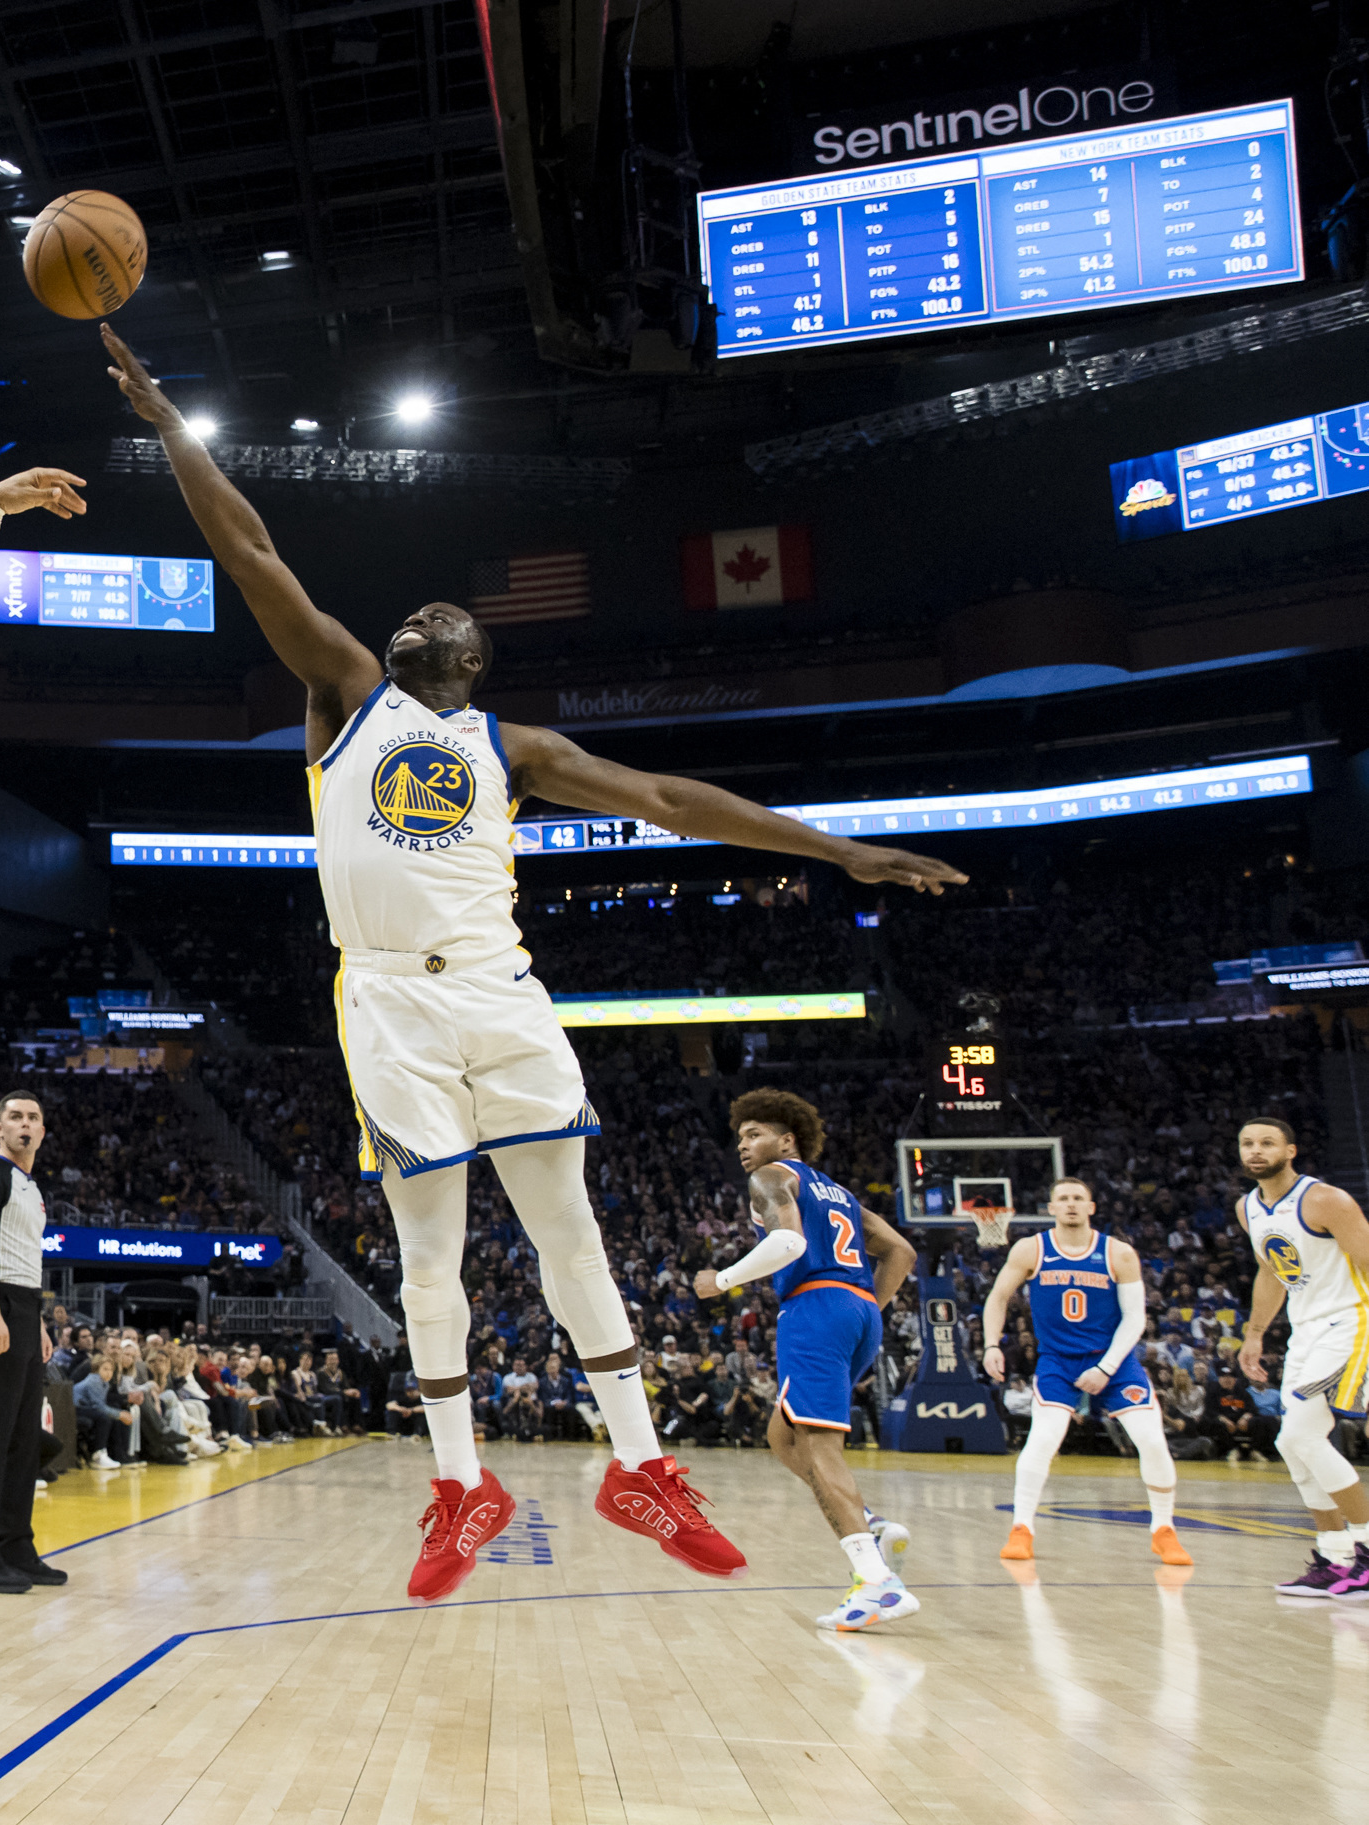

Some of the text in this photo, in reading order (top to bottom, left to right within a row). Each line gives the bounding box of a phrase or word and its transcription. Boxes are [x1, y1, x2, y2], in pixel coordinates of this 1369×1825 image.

[813, 80, 1154, 165] SentinelOne
[1059, 126, 1205, 160] NEW YORK TEAM STATS
[1160, 156, 1187, 169] BLK
[761, 172, 917, 207] GOLDEN STATE TEAM STATS
[1013, 165, 1107, 192] AST 14
[1161, 163, 1262, 190] TO 2
[865, 189, 956, 215] BLK 2
[1014, 187, 1109, 214] OREB 7
[1163, 186, 1263, 214] POT 4
[731, 210, 817, 235] AST 13
[866, 210, 957, 236] TO 5
[1016, 209, 1111, 235] DREB 15
[1165, 208, 1265, 235] PITP 24
[731, 242, 763, 256] OREB
[867, 232, 958, 256] POT 5
[1017, 231, 1112, 257] STL 1
[1230, 231, 1267, 250] 48.8
[733, 252, 819, 276] DREB 11
[868, 265, 897, 278] PITP
[1079, 253, 1113, 272] 54.2
[1223, 253, 1269, 275] 100.0
[734, 273, 821, 297] STL 1
[927, 274, 961, 292] 43.2
[1083, 275, 1116, 295] 41.2
[793, 294, 822, 312] 41.7
[921, 296, 963, 316] 100.0
[3, 556, 28, 619] xfinity
[558, 688, 643, 719] Modelo
[379, 731, 479, 766] GOLDEN STATE
[426, 762, 463, 790] 23
[366, 811, 475, 852] WARRIORS
[550, 826, 576, 848] 42
[426, 956, 445, 971] W
[949, 1046, 995, 1064] 3:58
[943, 1064, 985, 1096] 4.6
[955, 1101, 1002, 1111] TISSOT
[99, 1239, 183, 1258] HR solutions
[828, 1209, 863, 1268] 2
[1039, 1270, 1110, 1290] NEW YORK
[1061, 1289, 1087, 1322] 0
[614, 1491, 678, 1539] AIR
[457, 1502, 499, 1558] AIR
